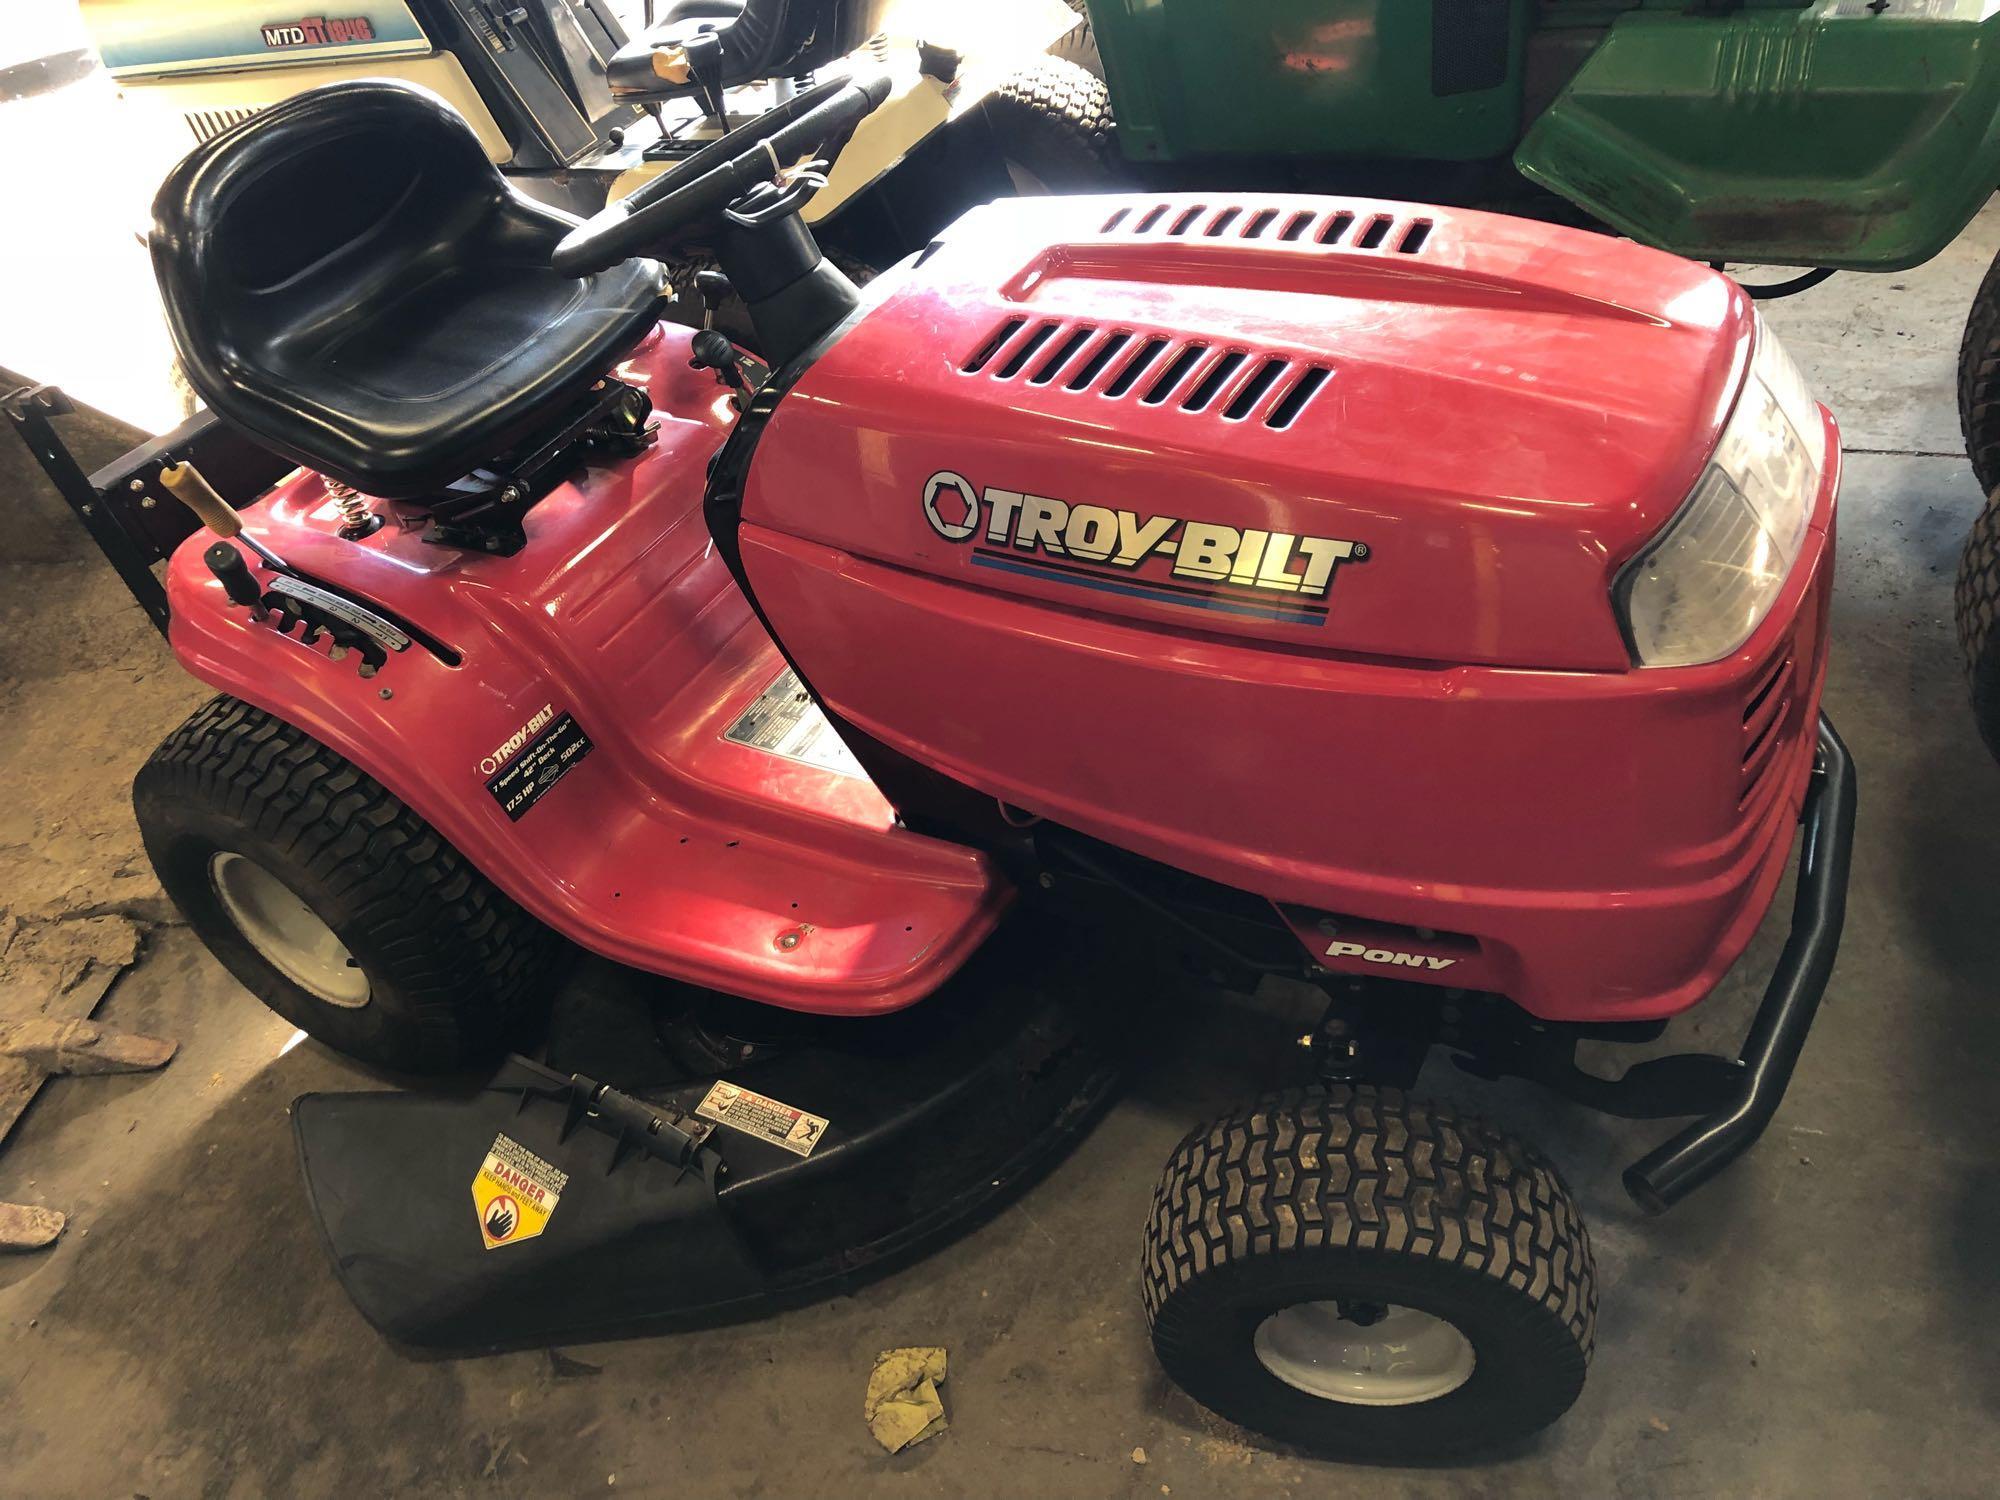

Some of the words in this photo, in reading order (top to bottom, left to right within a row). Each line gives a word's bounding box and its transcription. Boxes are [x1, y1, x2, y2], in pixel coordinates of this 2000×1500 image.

[264, 27, 305, 46] MTD
[491, 703, 554, 764] TROY-BILT
[523, 762, 537, 778] 42"
[537, 747, 556, 765] Deck
[560, 736, 586, 762] 502cc
[492, 785, 499, 793] 7
[499, 766, 520, 788] Speed
[522, 781, 535, 798] HP
[754, 1097, 792, 1116] DANGER
[483, 1171, 497, 1184] KEEP
[496, 1179, 513, 1195] HANDS
[519, 1194, 532, 1208] FEET
[531, 1201, 547, 1217] AWAY
[494, 1161, 546, 1203] DANGER
